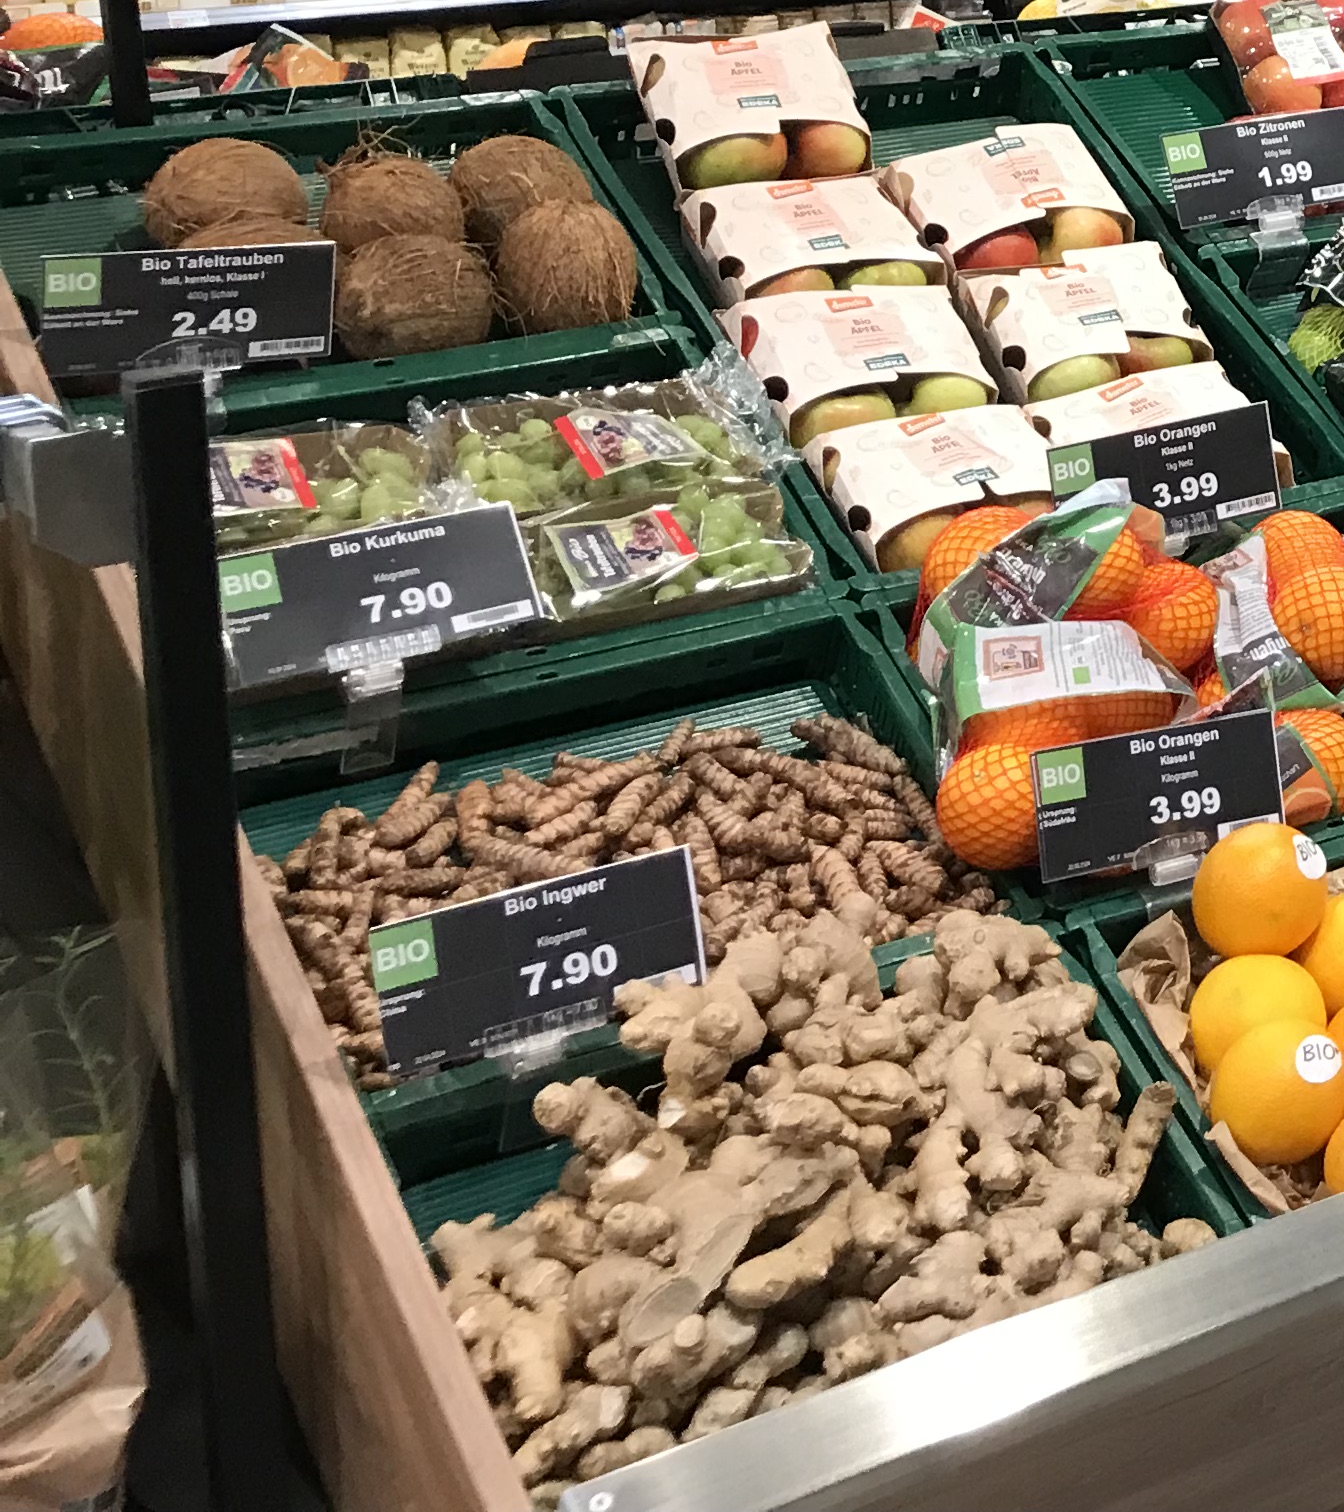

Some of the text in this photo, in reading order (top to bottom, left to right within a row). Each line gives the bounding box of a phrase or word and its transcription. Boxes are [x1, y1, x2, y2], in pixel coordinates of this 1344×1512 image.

[730, 67, 763, 76] ÄPFEL
[734, 60, 752, 68] Bio
[1236, 118, 1305, 138] Bio Zitronen
[1261, 136, 1280, 146] Klasse
[1168, 143, 1200, 162] BIO
[1258, 160, 1313, 188] 1.99
[793, 208, 826, 218] ÄPFEL
[141, 252, 284, 272] Bio Tafeltrauben
[49, 272, 97, 293] BIO
[184, 274, 224, 285] kernlos,
[226, 271, 259, 282] Klasse
[1067, 282, 1085, 290] Bio
[1065, 286, 1098, 298] ÄPFEL
[828, 298, 869, 311] demeter
[172, 307, 258, 338] 2.49
[851, 324, 884, 334] ÄPFEL
[853, 318, 871, 326] Bio
[869, 359, 907, 369] EDEKA
[1129, 396, 1150, 408] Bio
[1129, 399, 1162, 416] ÄPFEL
[931, 435, 951, 445] Bio
[1133, 421, 1216, 448] Bio Orangen
[1161, 444, 1187, 456] Klasse
[1053, 458, 1091, 481] BIO
[1178, 458, 1194, 469] Netz
[1152, 472, 1219, 508] 3.99
[329, 523, 447, 560] Bio Kurkuma
[224, 570, 274, 596] BIO
[360, 580, 454, 625] 7.90
[1130, 728, 1220, 755] Bio Orangen
[1160, 753, 1188, 766] Klasse
[1041, 763, 1081, 789] BIO
[1160, 770, 1199, 784] Kilogramm
[1149, 786, 1221, 825] 3.99
[1297, 841, 1318, 862] BIO
[504, 877, 607, 917] Bio Ingwer
[536, 927, 588, 949] Kilogramm
[376, 938, 430, 972] BIO
[520, 943, 618, 997] 7.90
[1302, 1043, 1336, 1062] BIO
